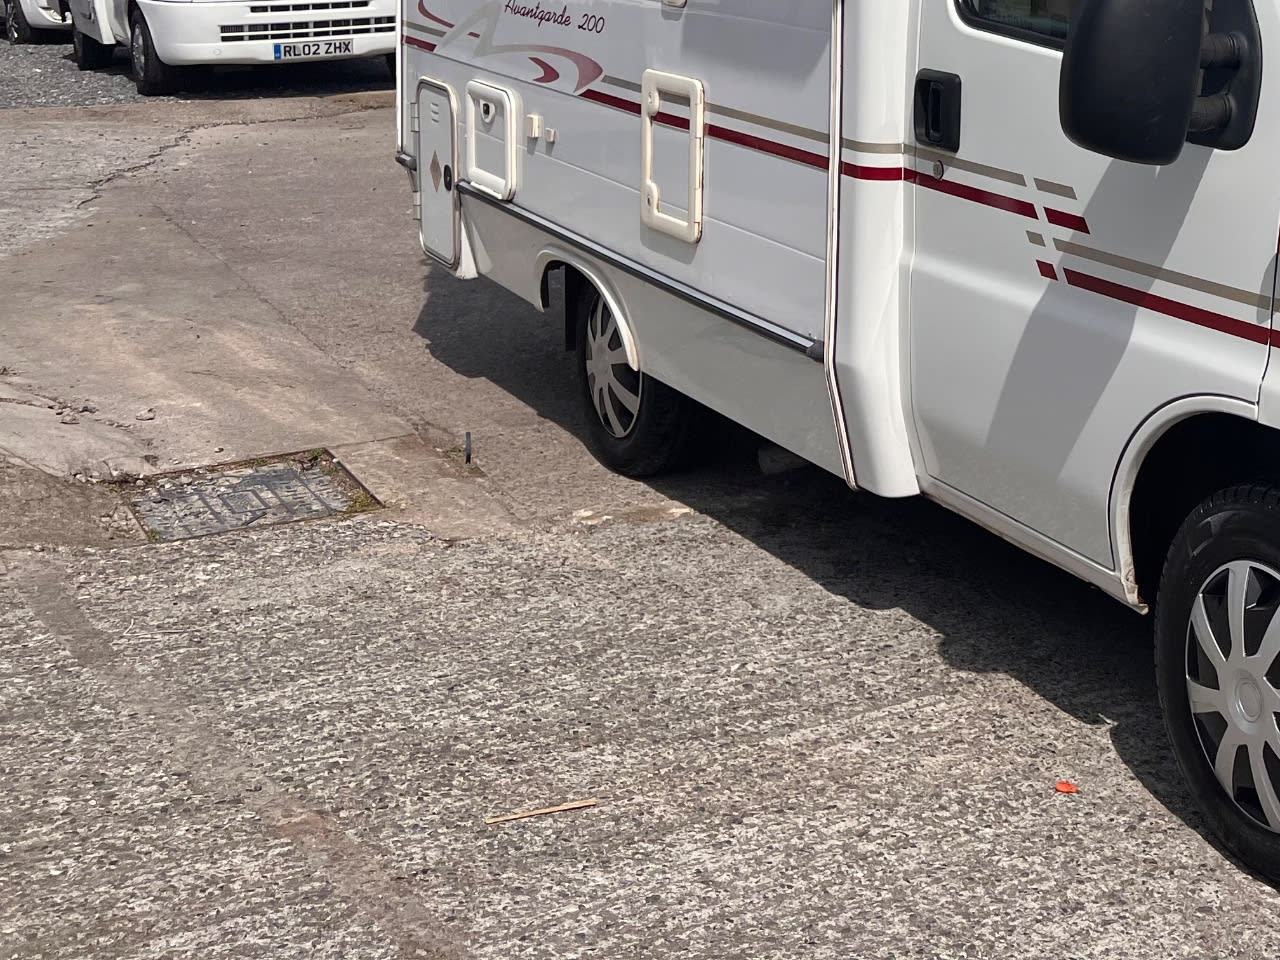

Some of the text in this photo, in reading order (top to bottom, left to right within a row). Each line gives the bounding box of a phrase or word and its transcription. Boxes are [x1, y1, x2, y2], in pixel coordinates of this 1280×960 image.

[577, 13, 605, 34] 200
[283, 41, 351, 57] RL02 ZHX
